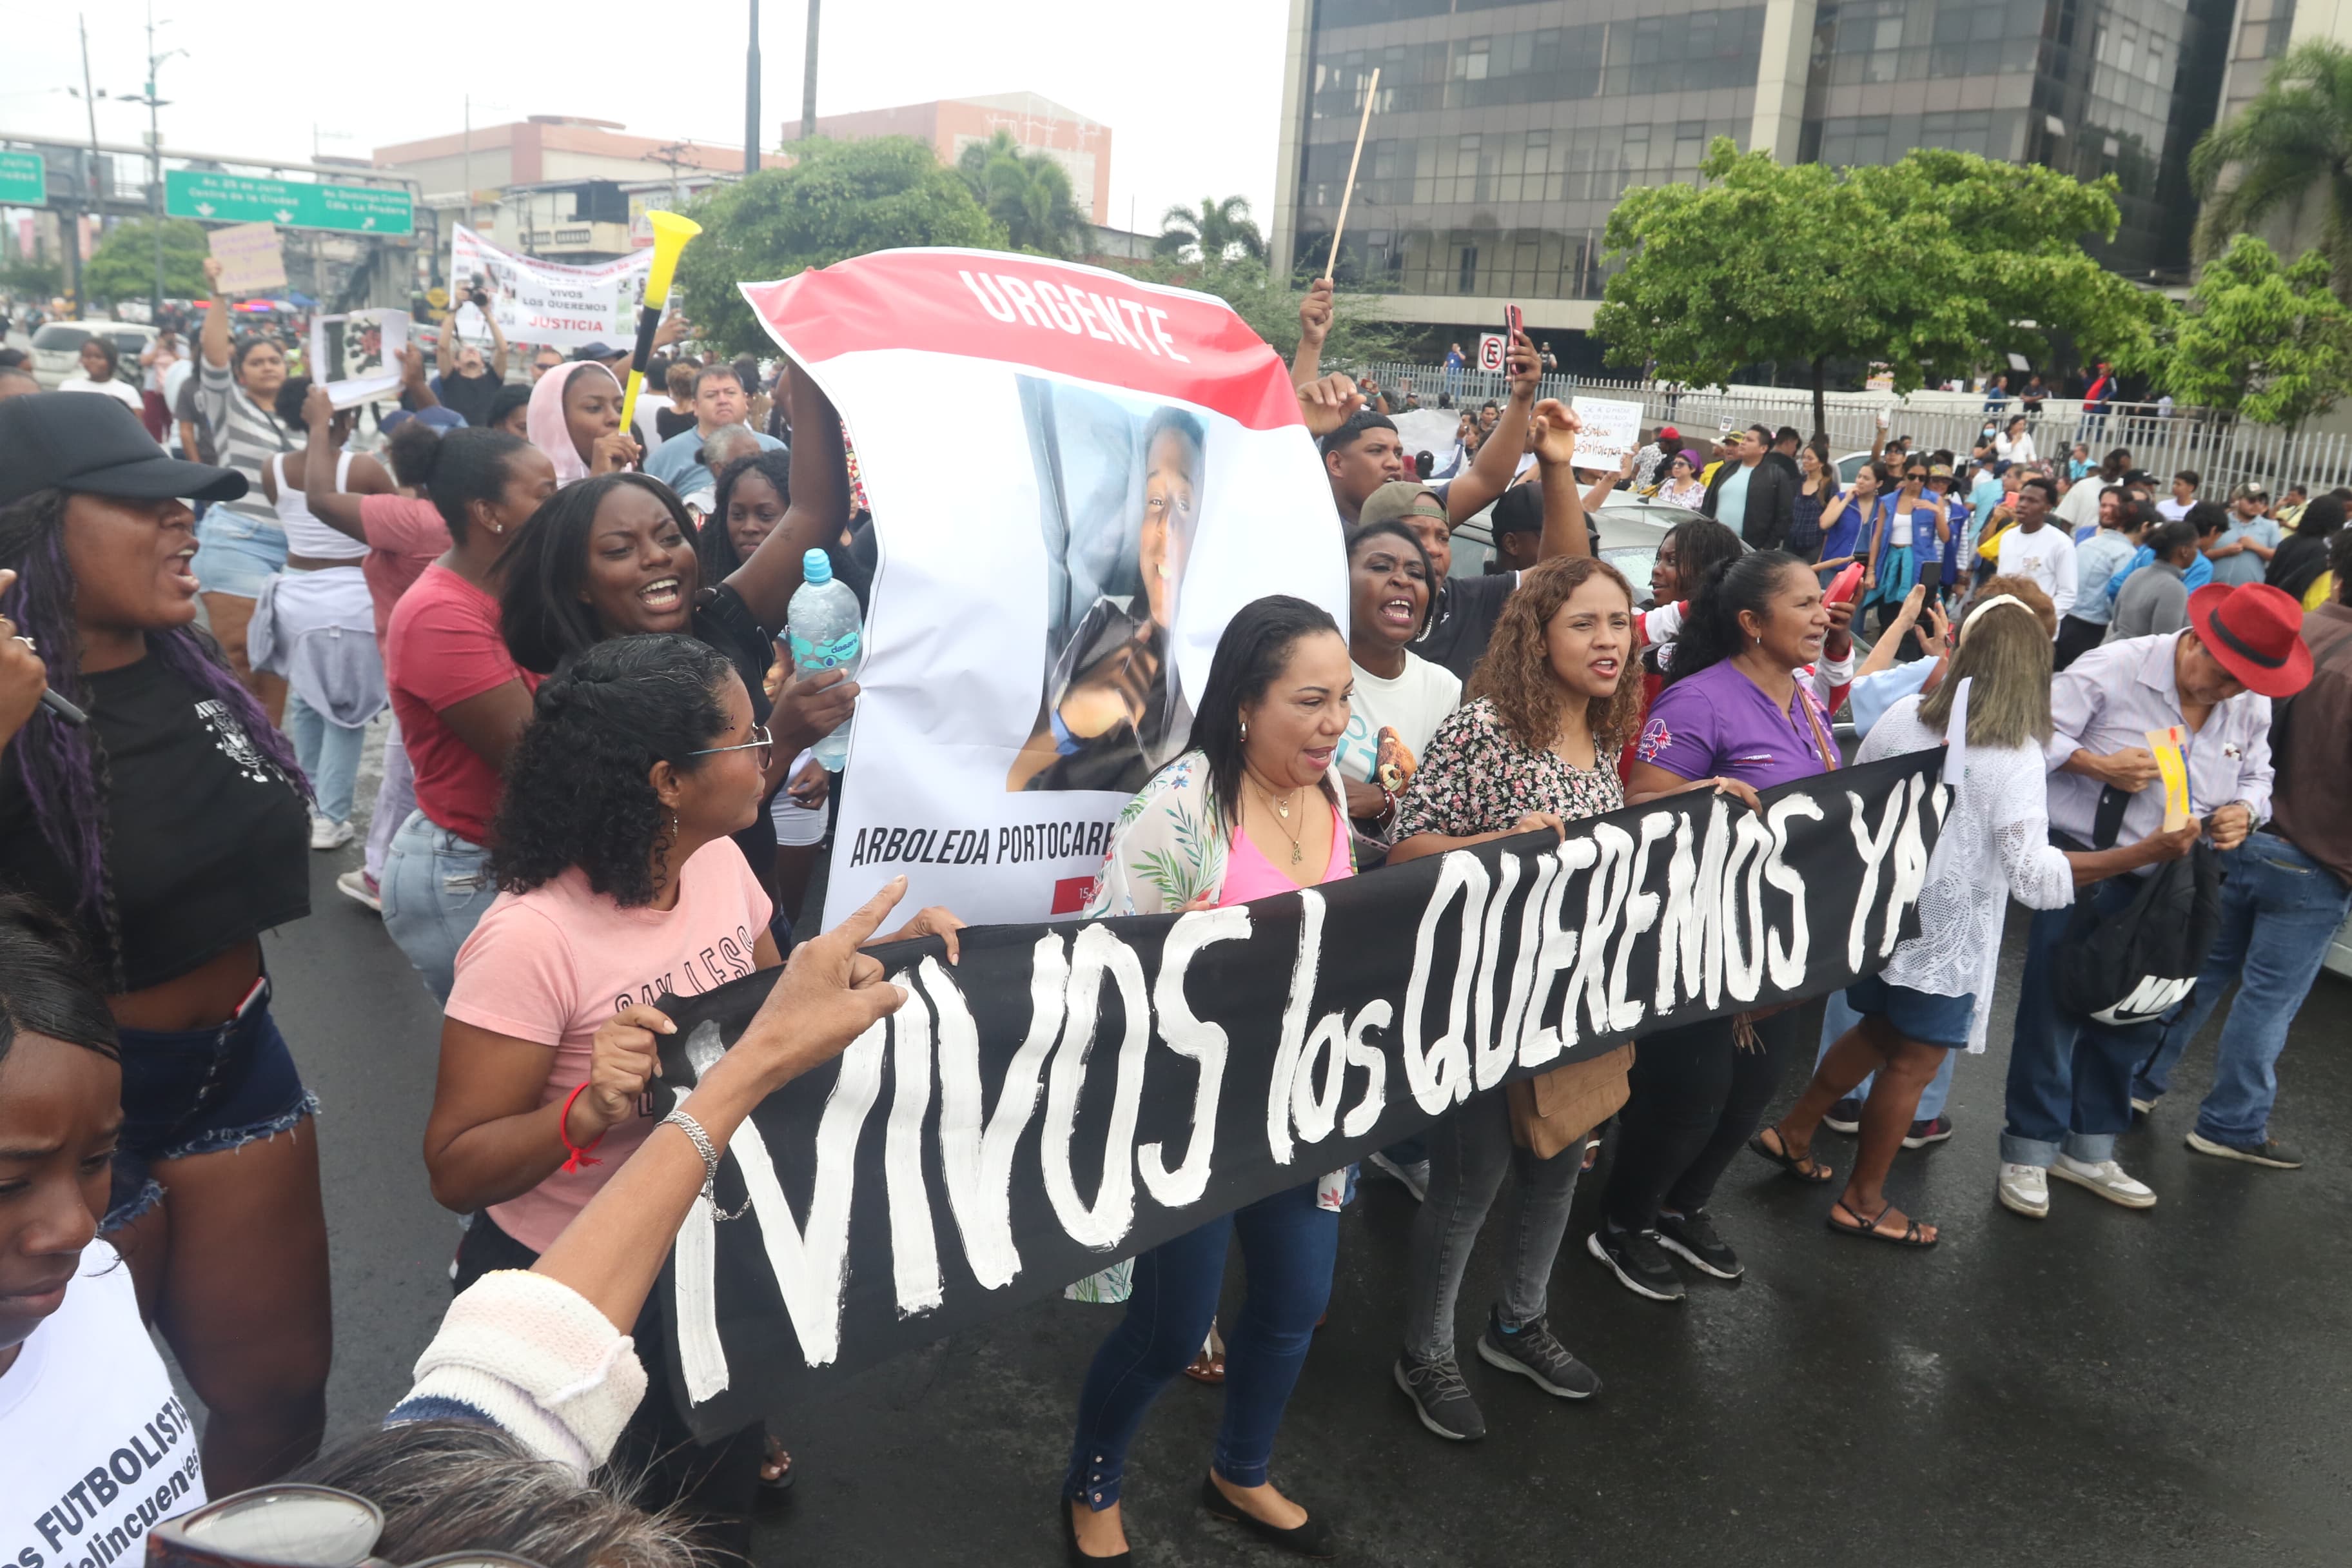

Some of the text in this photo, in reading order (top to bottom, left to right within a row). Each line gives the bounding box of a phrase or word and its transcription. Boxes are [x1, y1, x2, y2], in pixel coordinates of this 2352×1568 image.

[523, 298, 607, 311] LOS QUEREMOS
[550, 289, 583, 299] VIVOS
[529, 315, 603, 331] JUSTICIA
[959, 270, 1191, 364] URGENTE
[849, 827, 990, 868] ARBOLEDA
[1267, 887, 1394, 1166] los
[1403, 792, 1825, 1117] QUEREMOS
